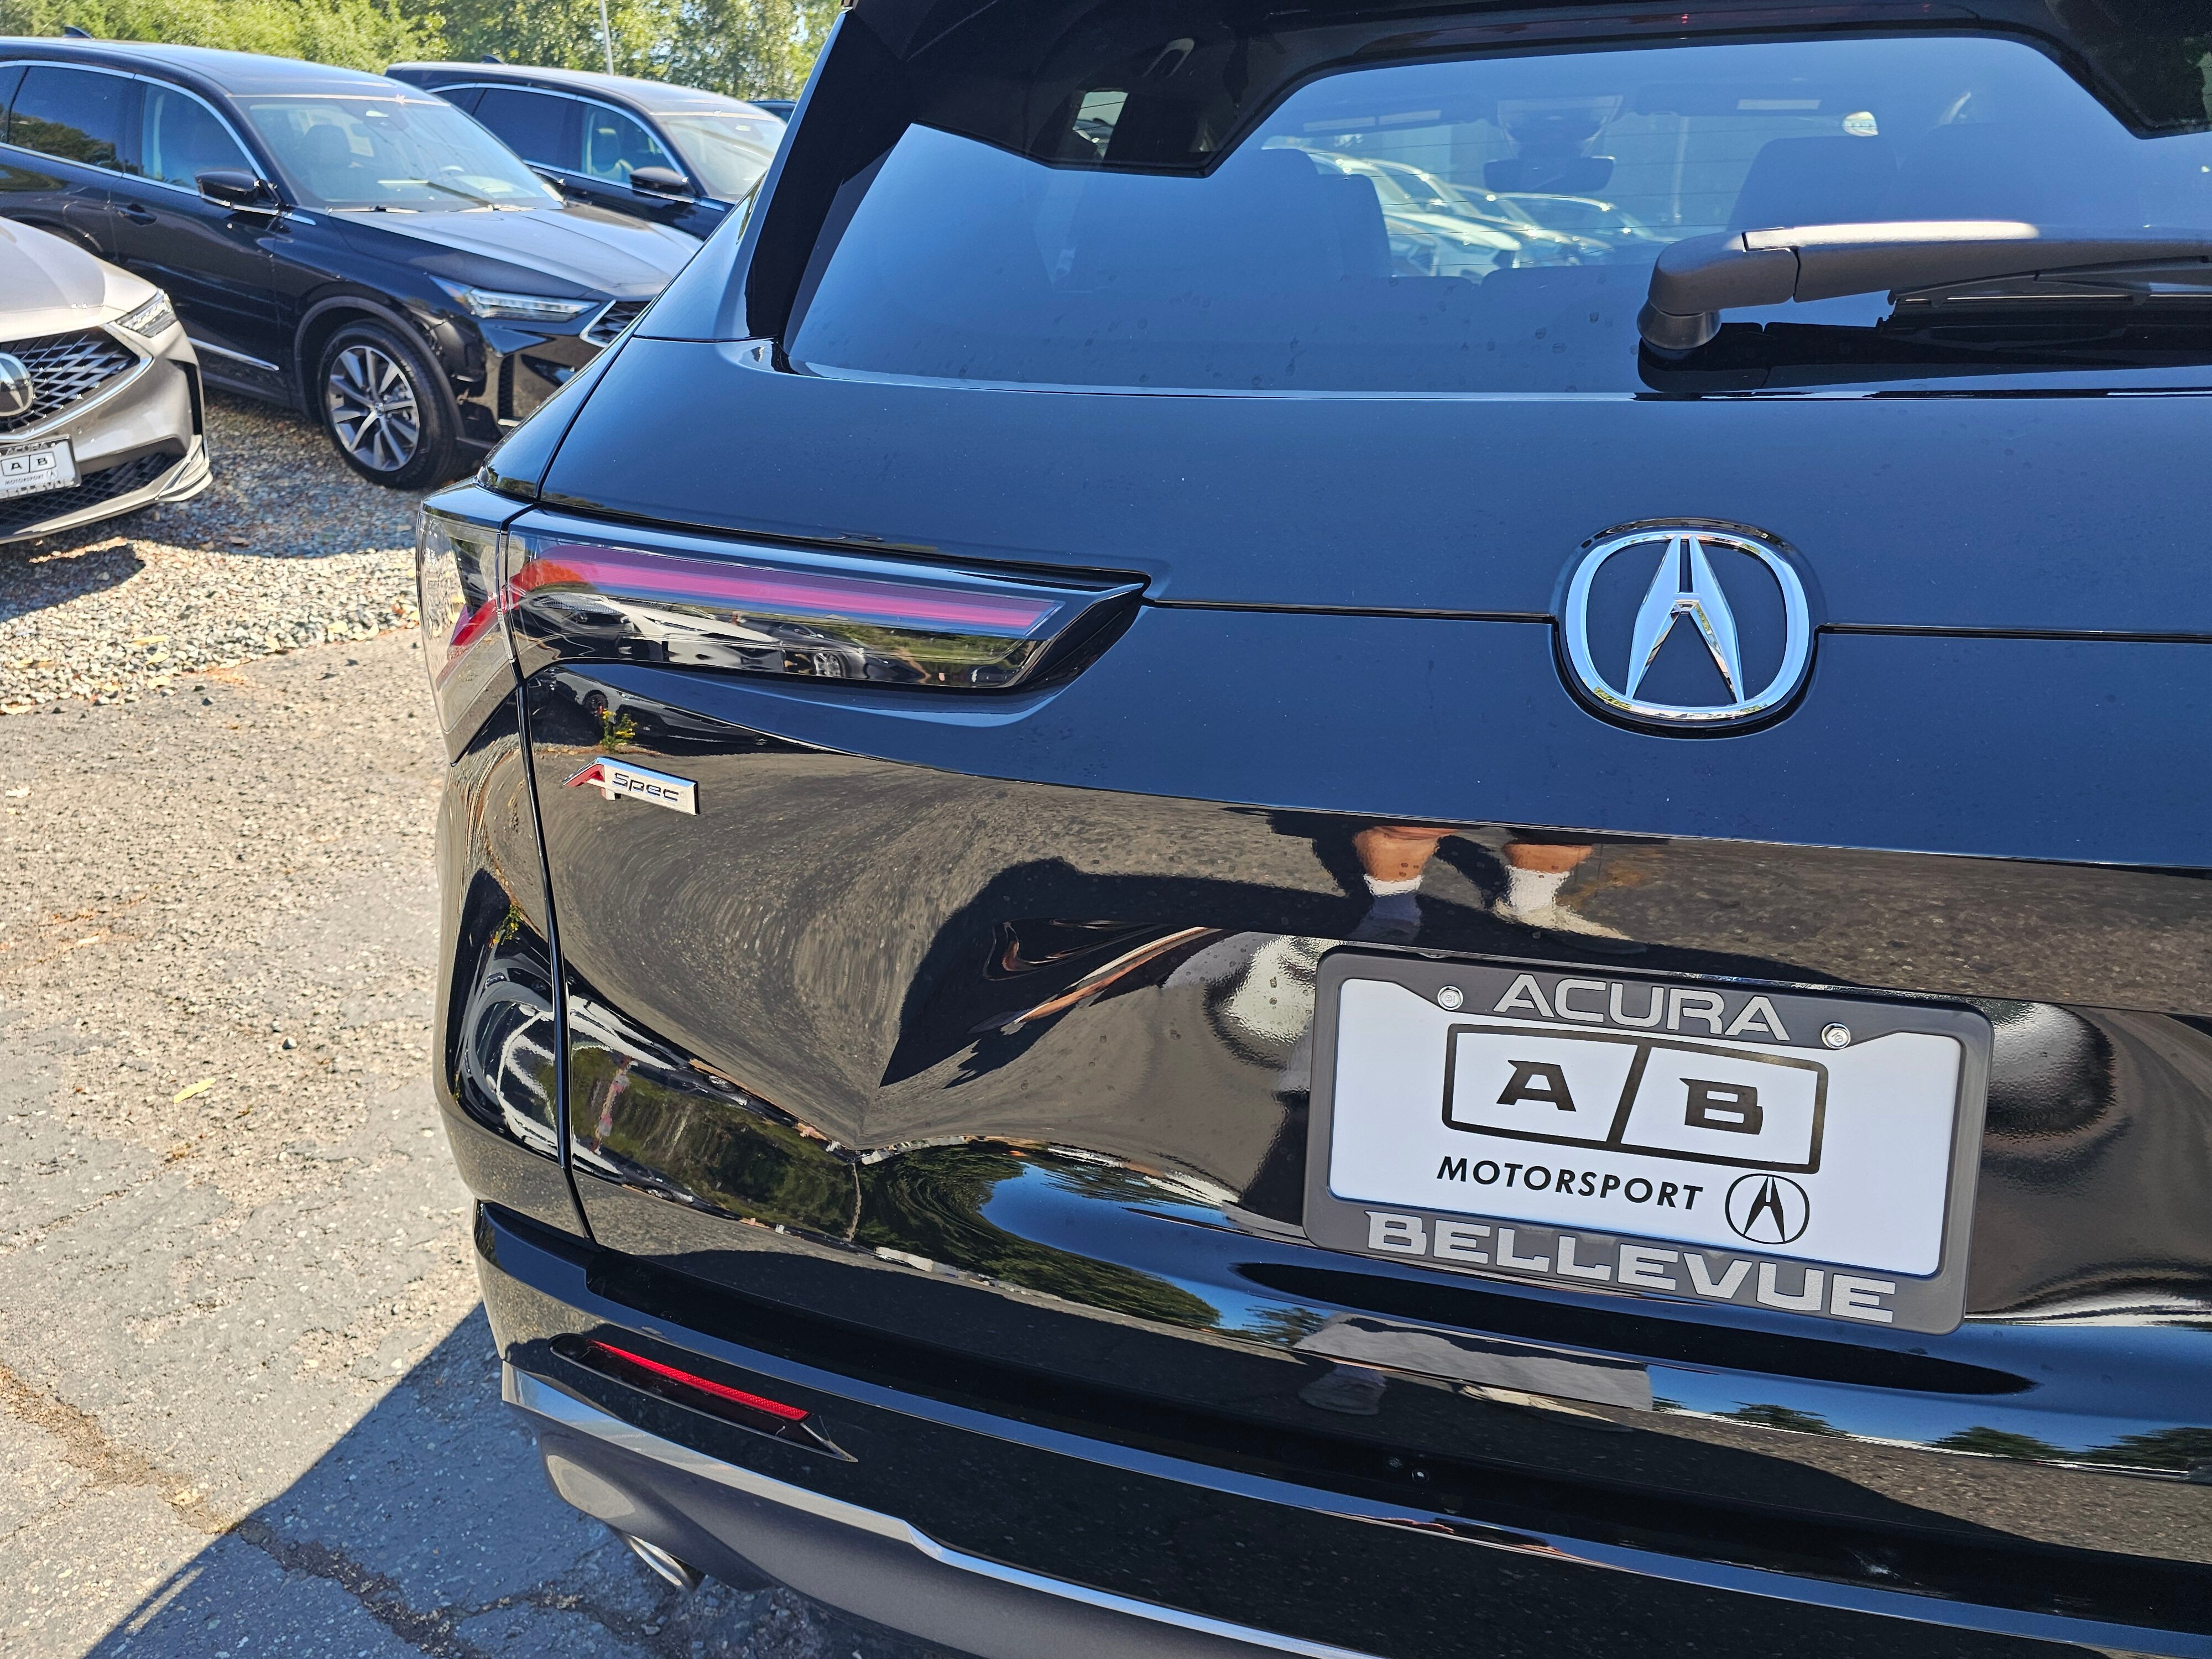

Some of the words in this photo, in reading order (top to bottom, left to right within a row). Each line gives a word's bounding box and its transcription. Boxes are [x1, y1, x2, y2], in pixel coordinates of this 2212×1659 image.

[6, 442, 48, 456] ACURA
[11, 462, 22, 471] A
[37, 457, 48, 466] B
[1493, 973, 1791, 1042] ACURA
[1496, 1060, 1577, 1112] A
[1679, 1077, 1764, 1135] B
[1437, 1156, 1704, 1211] MOTORSPORT
[1364, 1210, 1896, 1324] BELLEVUE
